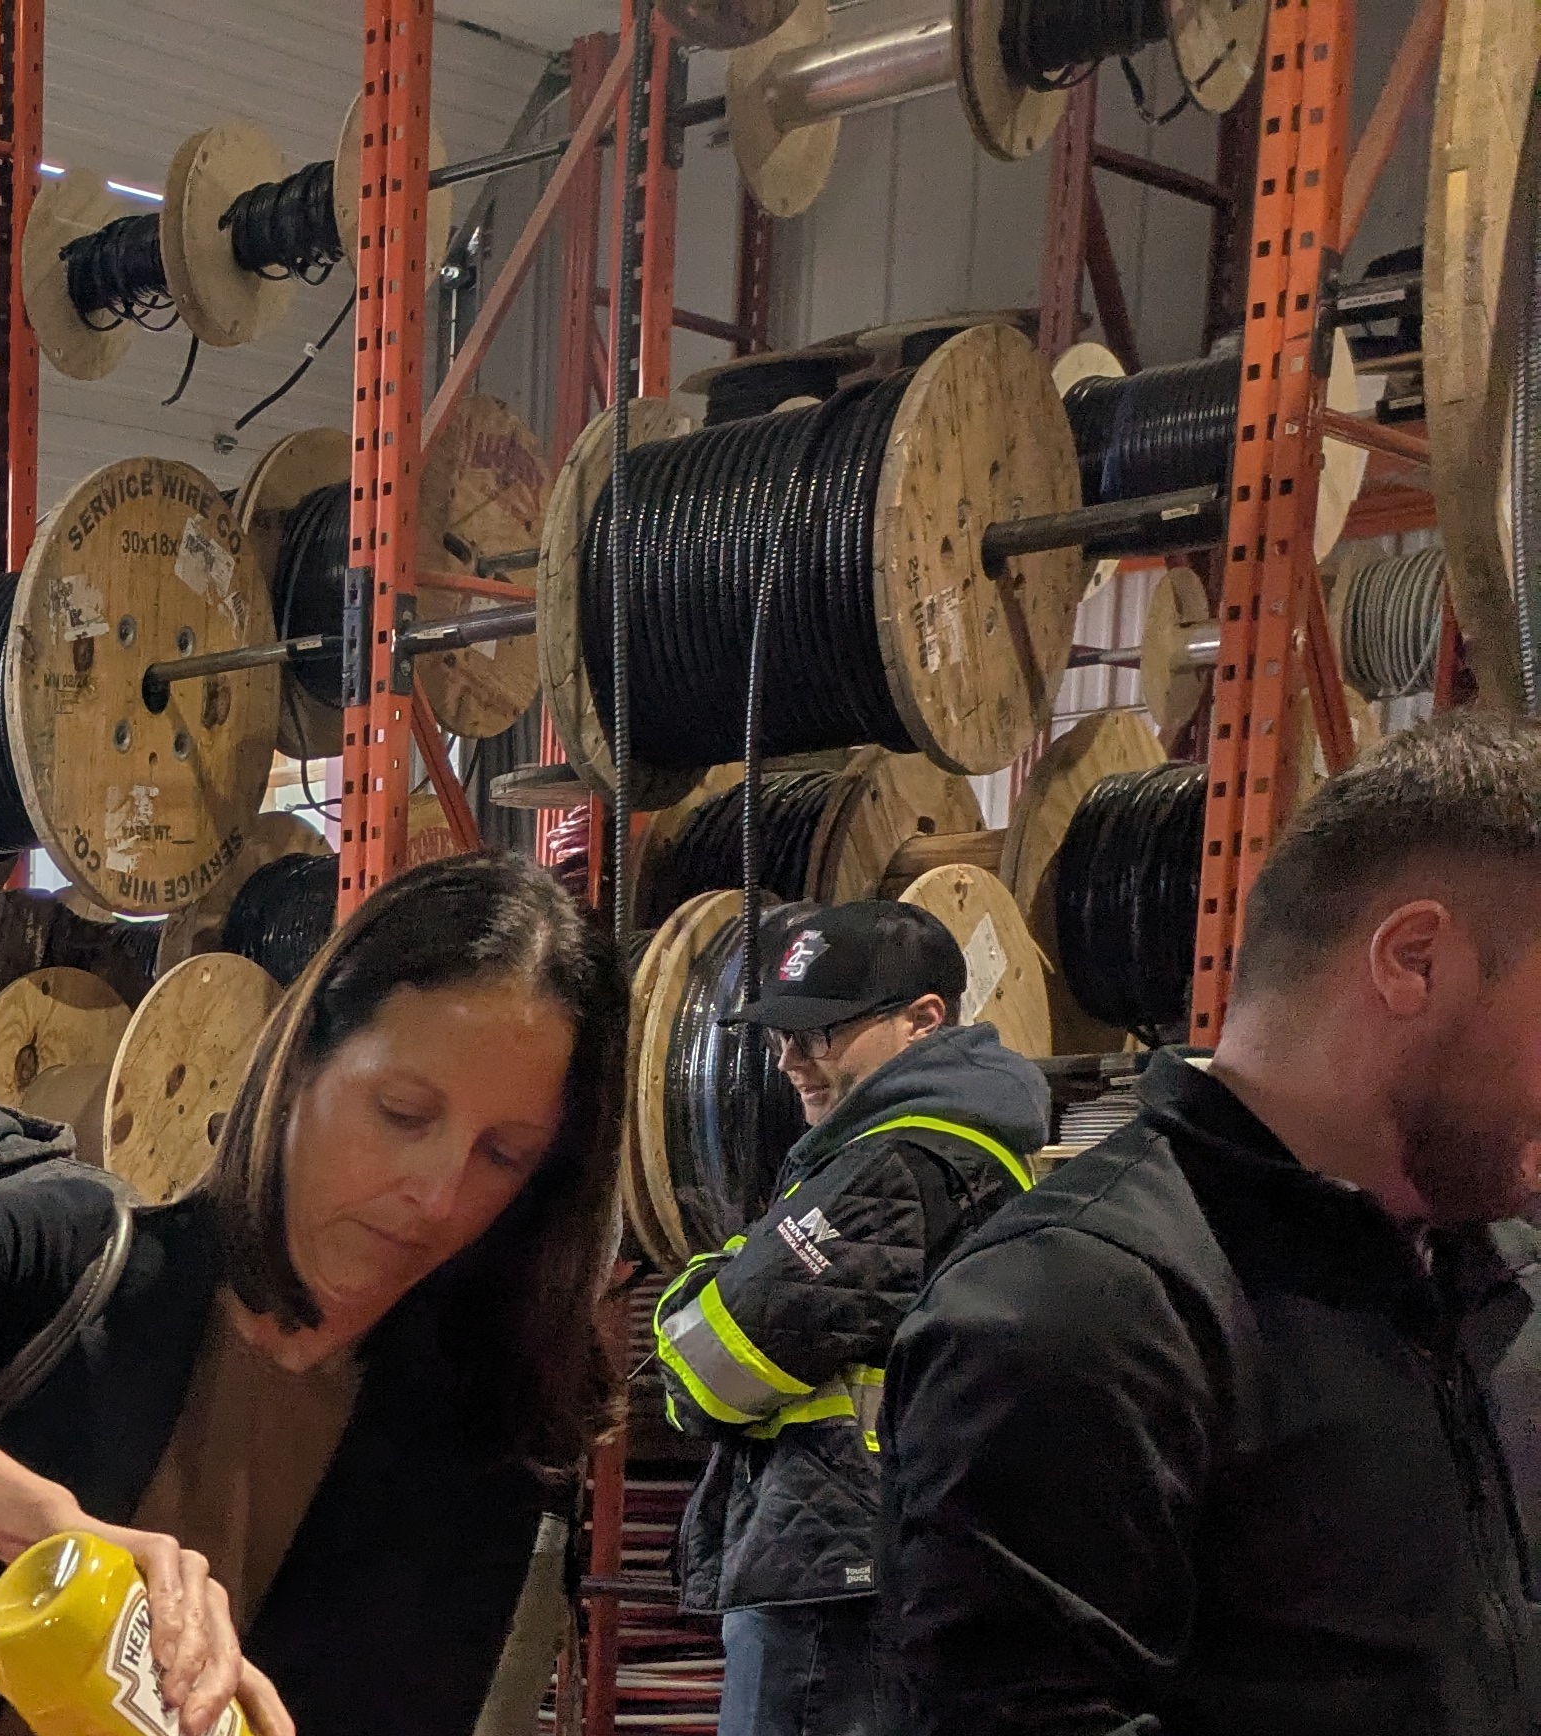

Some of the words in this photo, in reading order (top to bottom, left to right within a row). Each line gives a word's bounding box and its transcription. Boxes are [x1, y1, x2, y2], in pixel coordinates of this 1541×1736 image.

[68, 471, 154, 551] SERVICE
[161, 474, 211, 518] WIRE
[783, 1215, 809, 1243] POINT
[803, 1239, 833, 1269] WEST
